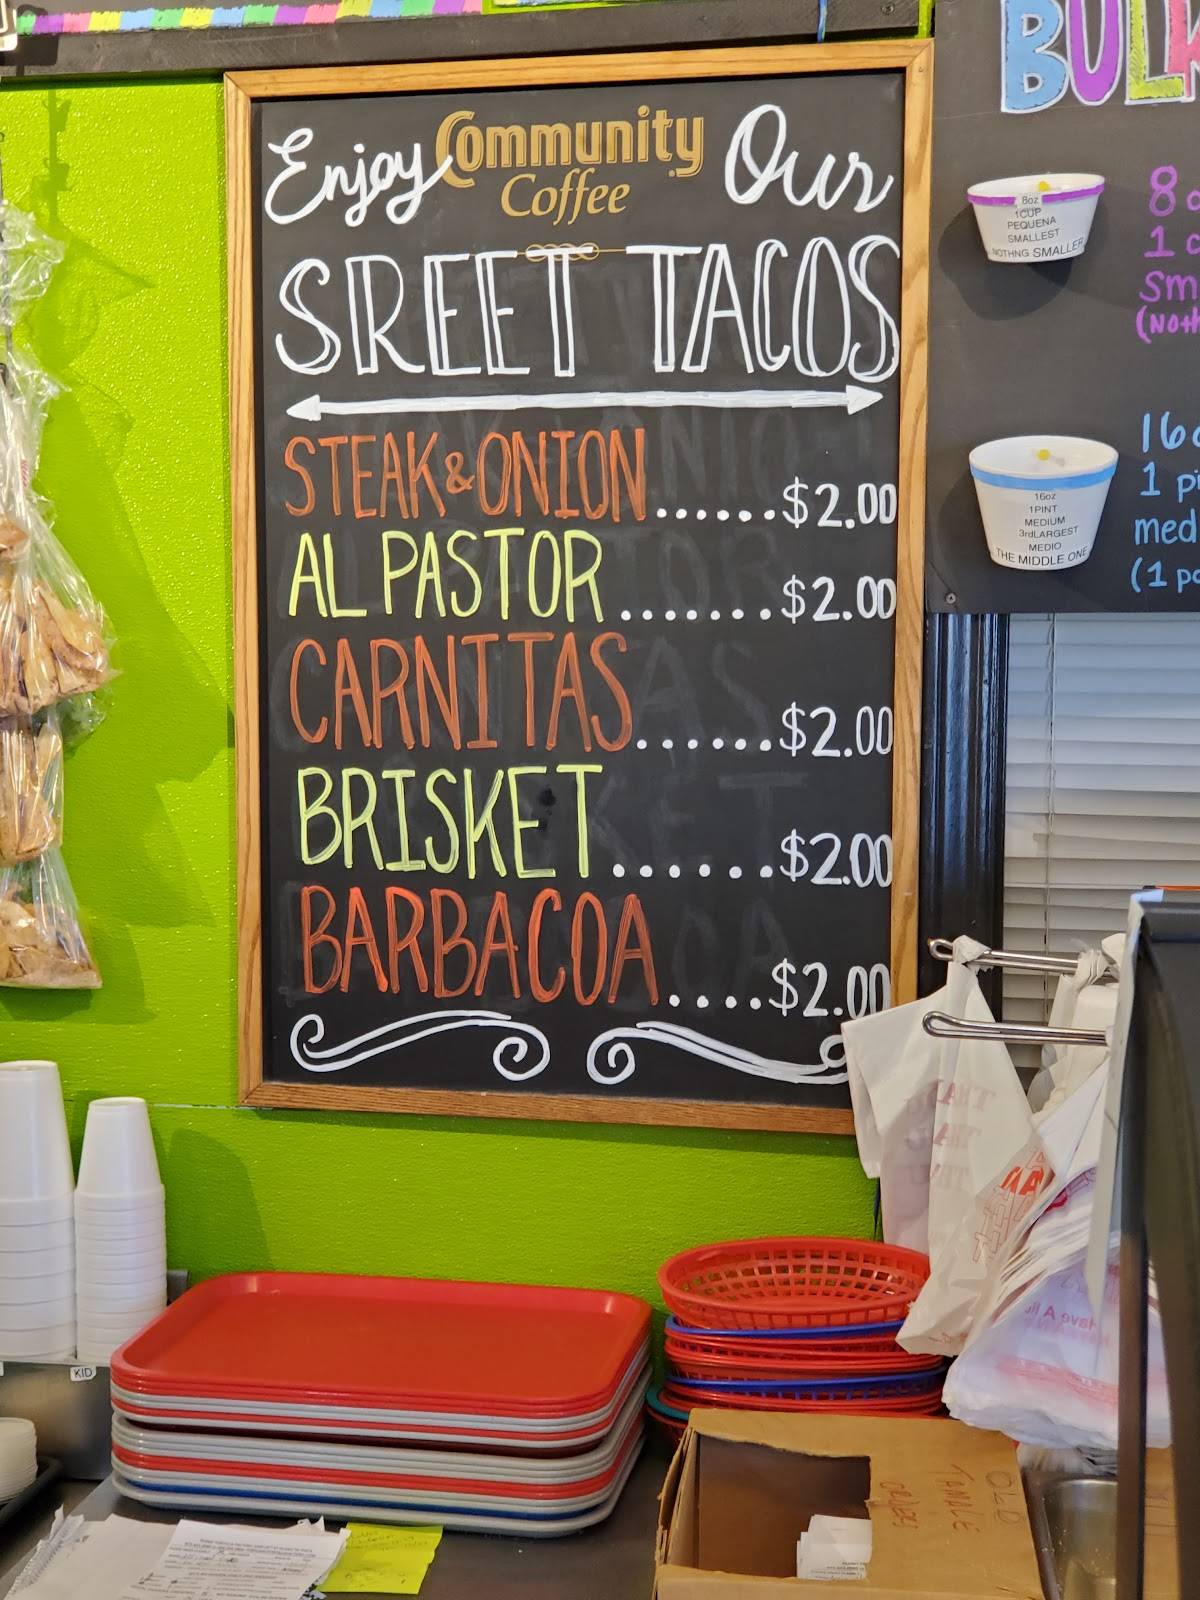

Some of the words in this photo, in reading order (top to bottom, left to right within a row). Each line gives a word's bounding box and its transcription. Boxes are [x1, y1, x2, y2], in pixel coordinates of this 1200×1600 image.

[265, 127, 452, 226] Enjoy
[435, 105, 705, 188] Community
[725, 104, 894, 213] Our
[500, 166, 631, 226] Coffee
[1022, 196, 1039, 205] 8oz
[1149, 165, 1178, 217] 8
[1007, 216, 1057, 230] PEQUENA
[1015, 208, 1042, 219] 1CUP
[1007, 228, 1060, 243] SMALLEST
[1033, 236, 1085, 258] SMALLER
[1144, 225, 1175, 258] 1
[275, 246, 596, 378] SREET
[626, 235, 900, 383] TACOS
[1140, 461, 1161, 496] 1
[782, 477, 896, 529] $2.00
[1030, 505, 1058, 514] 1PINT
[1034, 493, 1057, 501] 16oz
[1018, 526, 1079, 539] 3rdLARGEST
[1024, 516, 1066, 527] MEDIUM
[995, 547, 1016, 563] THE
[1018, 553, 1064, 567] MIDDLE
[1067, 546, 1088, 563] ONE
[1028, 541, 1062, 552] MEDIO
[288, 531, 367, 617] AL
[382, 528, 604, 623] PASTOR
[780, 575, 896, 624] $2.00
[290, 632, 633, 752] CARNITAS
[779, 702, 893, 757] $2.00
[297, 764, 603, 879] BRISKET
[780, 829, 893, 888] $2.00
[300, 886, 659, 1006] BARBACOA
[768, 958, 892, 1019] $2.00
[73, 1367, 93, 1379] KID
[984, 1470, 1026, 1524] OLD
